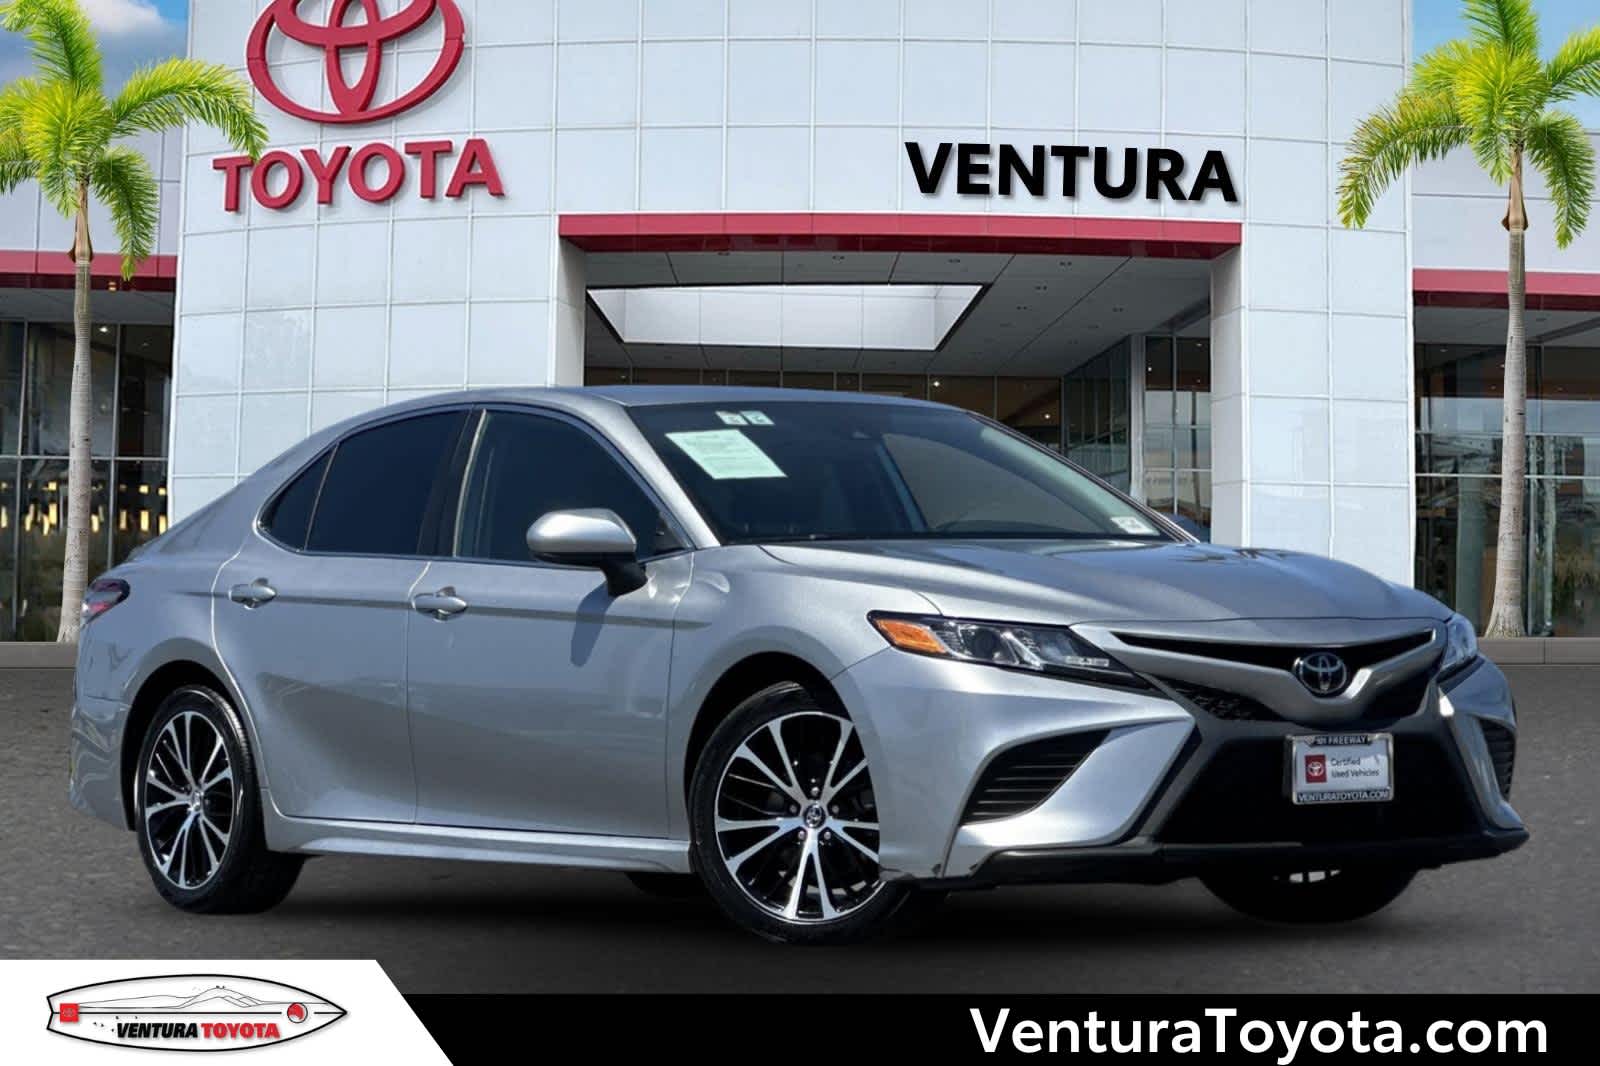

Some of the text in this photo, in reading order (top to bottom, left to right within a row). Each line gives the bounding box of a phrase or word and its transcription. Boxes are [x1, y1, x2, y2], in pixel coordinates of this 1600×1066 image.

[212, 138, 505, 212] TOYOTA
[904, 141, 1239, 203] VENTURA
[1331, 756, 1361, 767] Certified
[1331, 767, 1380, 778] Used Vehicles
